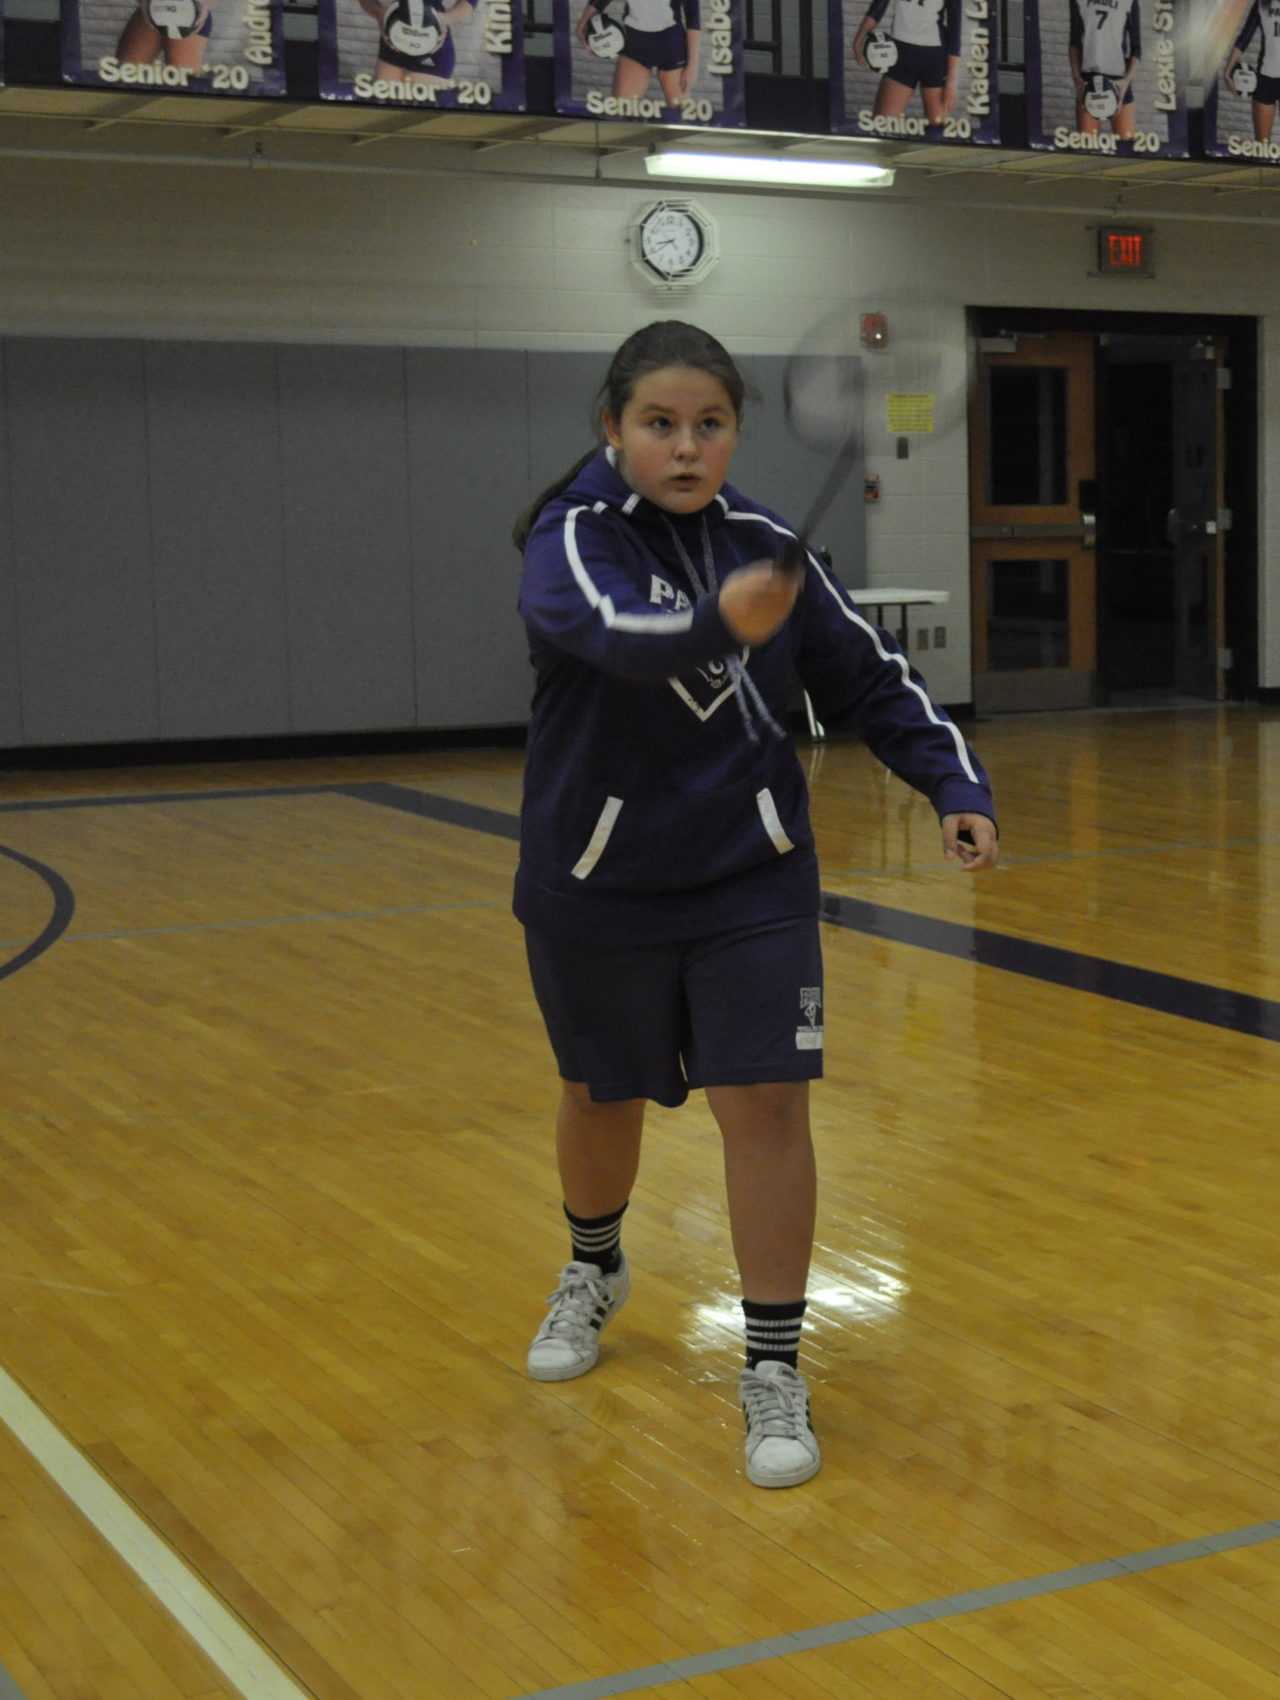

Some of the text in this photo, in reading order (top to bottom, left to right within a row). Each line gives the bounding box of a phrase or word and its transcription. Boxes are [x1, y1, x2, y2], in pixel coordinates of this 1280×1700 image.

[1095, 10, 1109, 30] 7
[98, 56, 193, 87] Senior
[966, 27, 990, 115] Kaden
[1151, 39, 1176, 111] Lexie
[353, 73, 442, 103] Senior
[586, 90, 667, 119] Senior
[857, 109, 929, 136] Senior
[1053, 126, 1121, 151] Senior
[1107, 233, 1143, 267] EXIT
